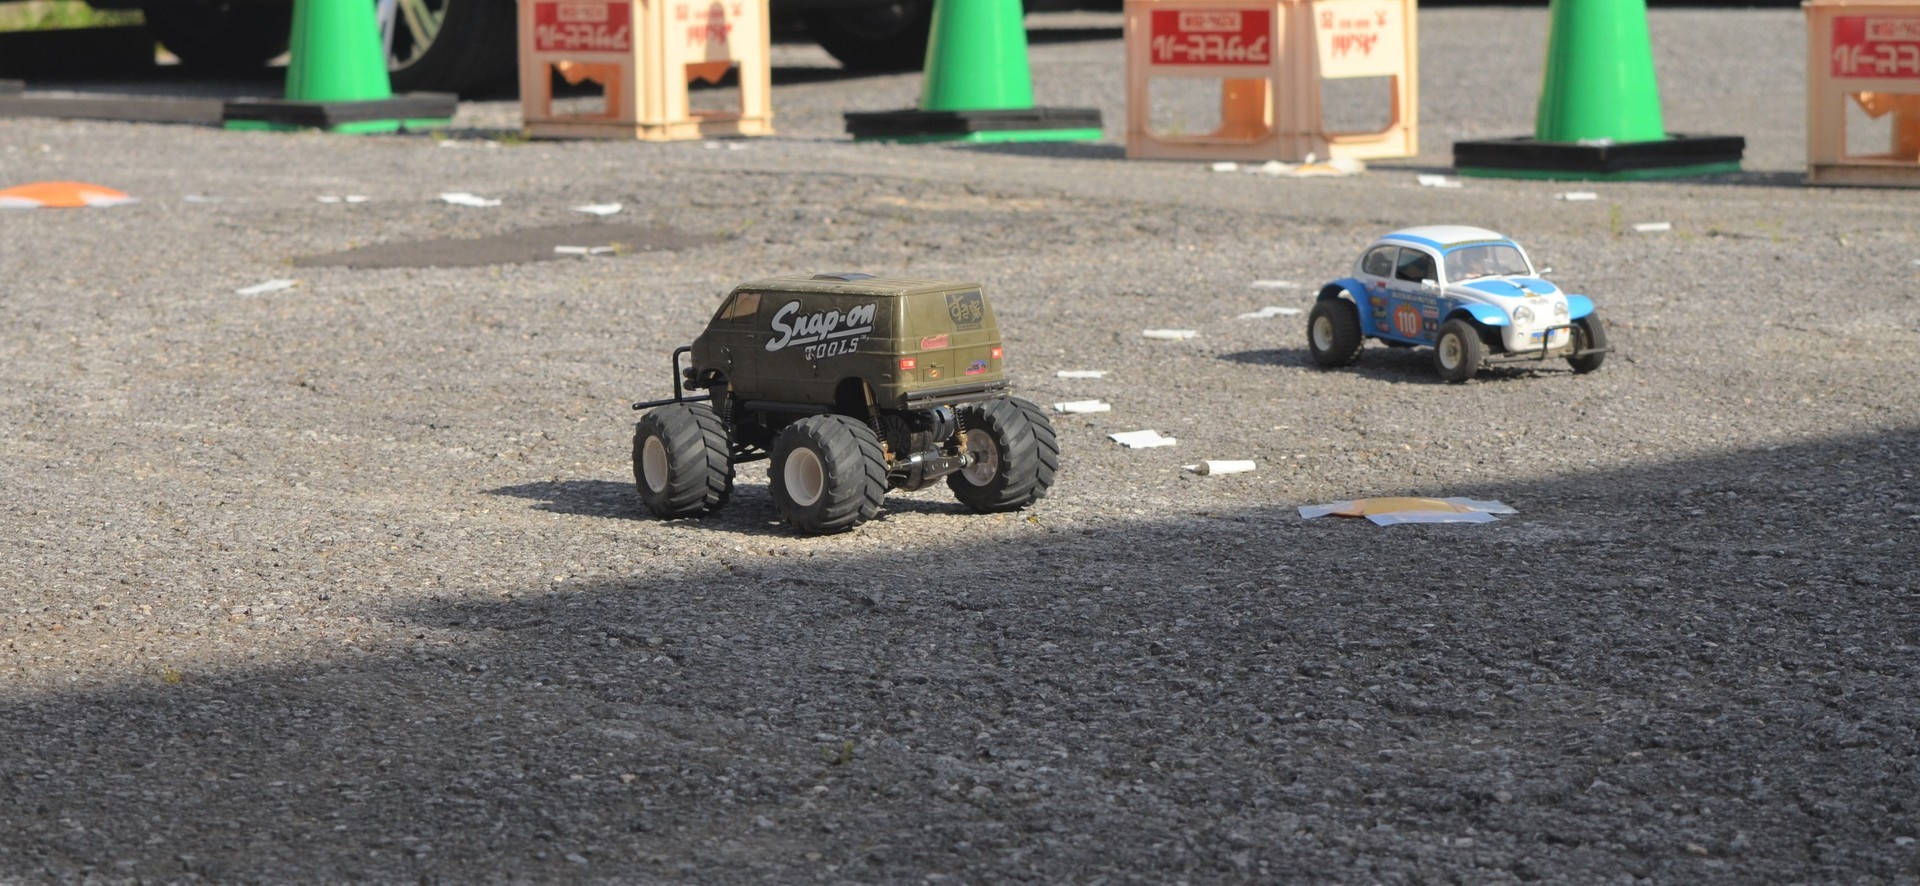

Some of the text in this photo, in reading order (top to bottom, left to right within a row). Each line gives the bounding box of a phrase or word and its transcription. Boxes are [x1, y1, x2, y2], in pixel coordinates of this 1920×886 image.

[537, 24, 629, 48] アサヒビール
[1153, 34, 1268, 61] アサヒビール
[1834, 44, 1919, 74] ヒビール
[765, 301, 876, 352] Snap-on
[1397, 311, 1417, 335] 110
[804, 337, 859, 361] TOOLS
